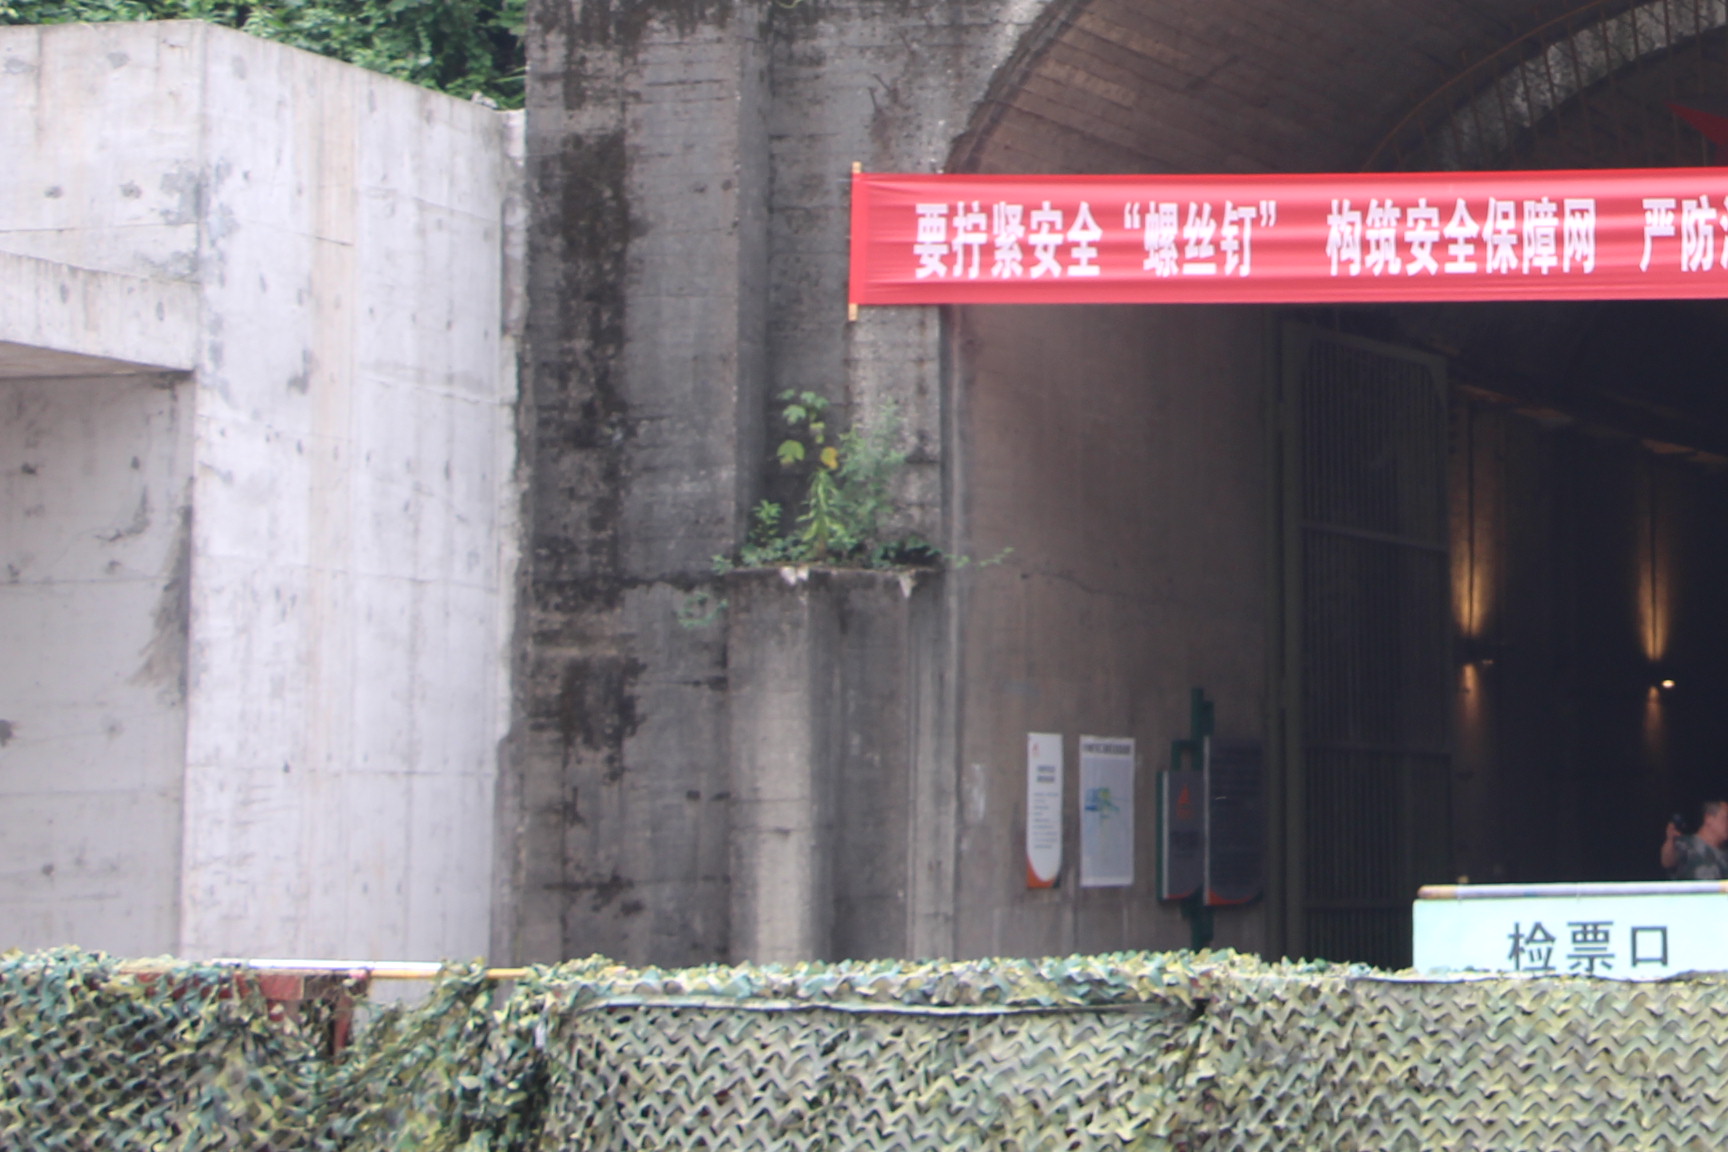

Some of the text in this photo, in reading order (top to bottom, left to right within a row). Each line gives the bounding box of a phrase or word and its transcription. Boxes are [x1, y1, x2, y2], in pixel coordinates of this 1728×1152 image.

[1326, 196, 1597, 276] 构筑安全保障网
[1507, 921, 1669, 973] 检票口
